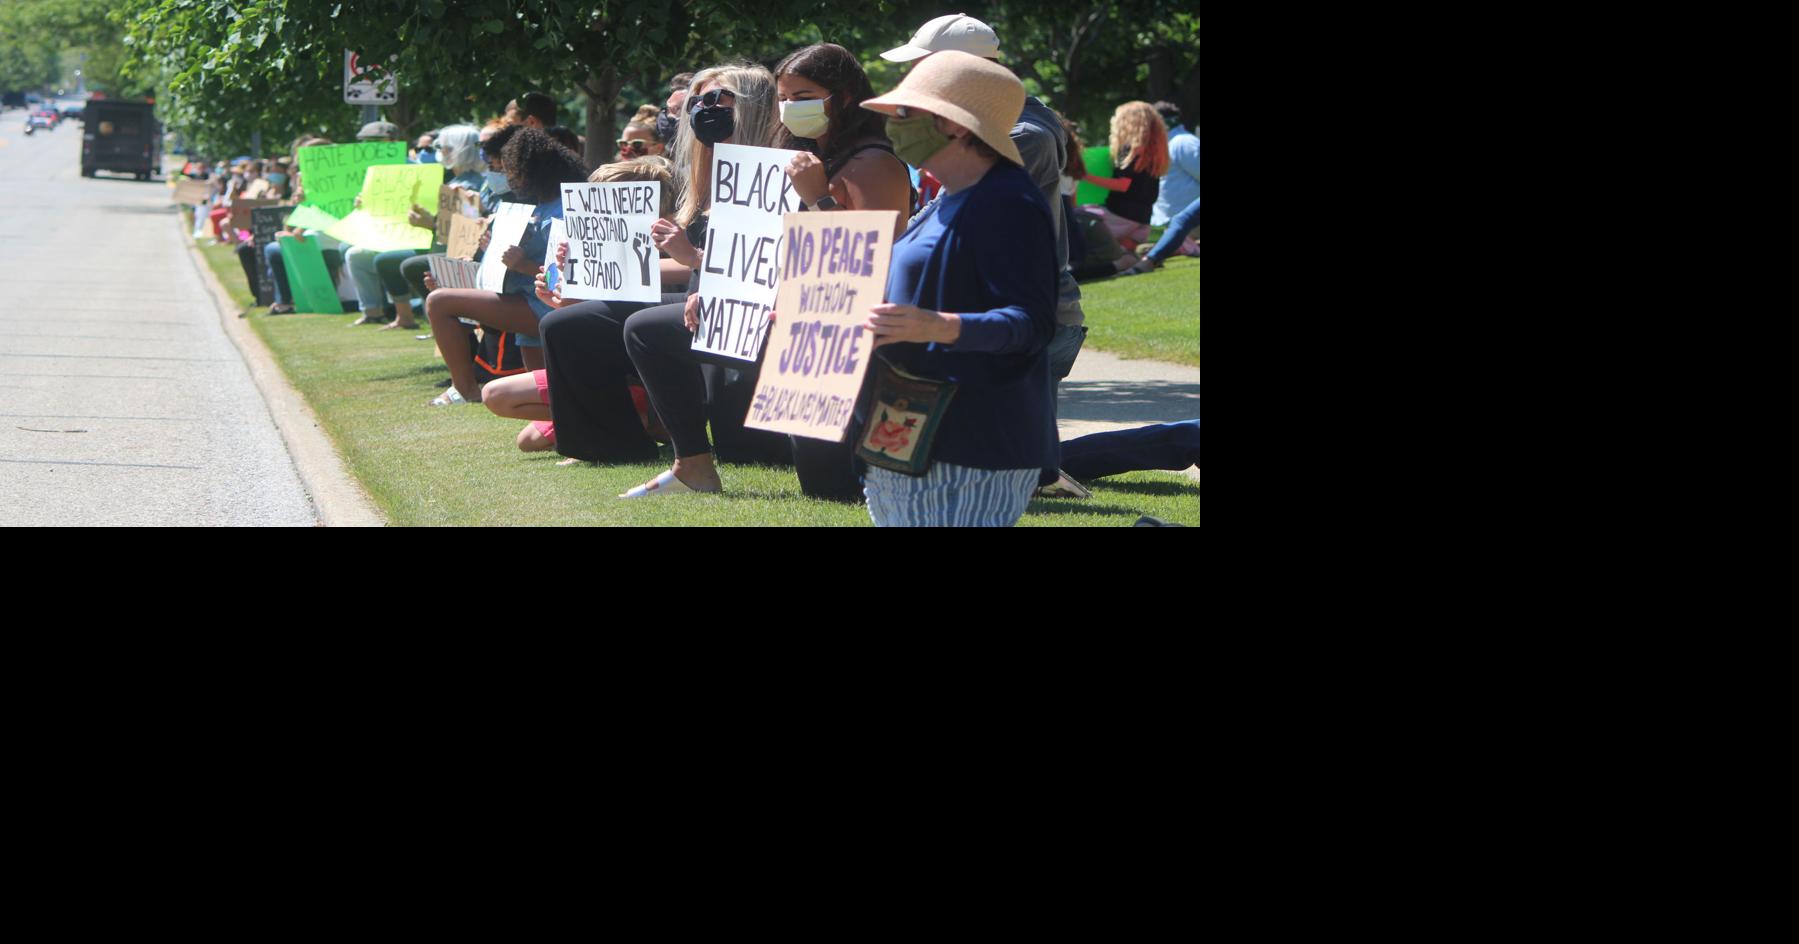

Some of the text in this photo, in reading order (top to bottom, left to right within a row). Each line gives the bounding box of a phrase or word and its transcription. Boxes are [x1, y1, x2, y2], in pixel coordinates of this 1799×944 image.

[352, 141, 399, 164] DOES
[307, 175, 337, 193] NOT
[565, 186, 654, 215] I WILL NEVER
[715, 159, 793, 216] BLACK
[565, 215, 629, 243] UNDERSTAND
[582, 241, 604, 261] BUT
[705, 228, 783, 289] LIVES
[783, 225, 879, 281] NO PEACE
[566, 258, 622, 291] I STAND
[799, 282, 858, 315] WITHOUT
[694, 296, 772, 357] MATTER
[778, 320, 864, 378] JUSTICE
